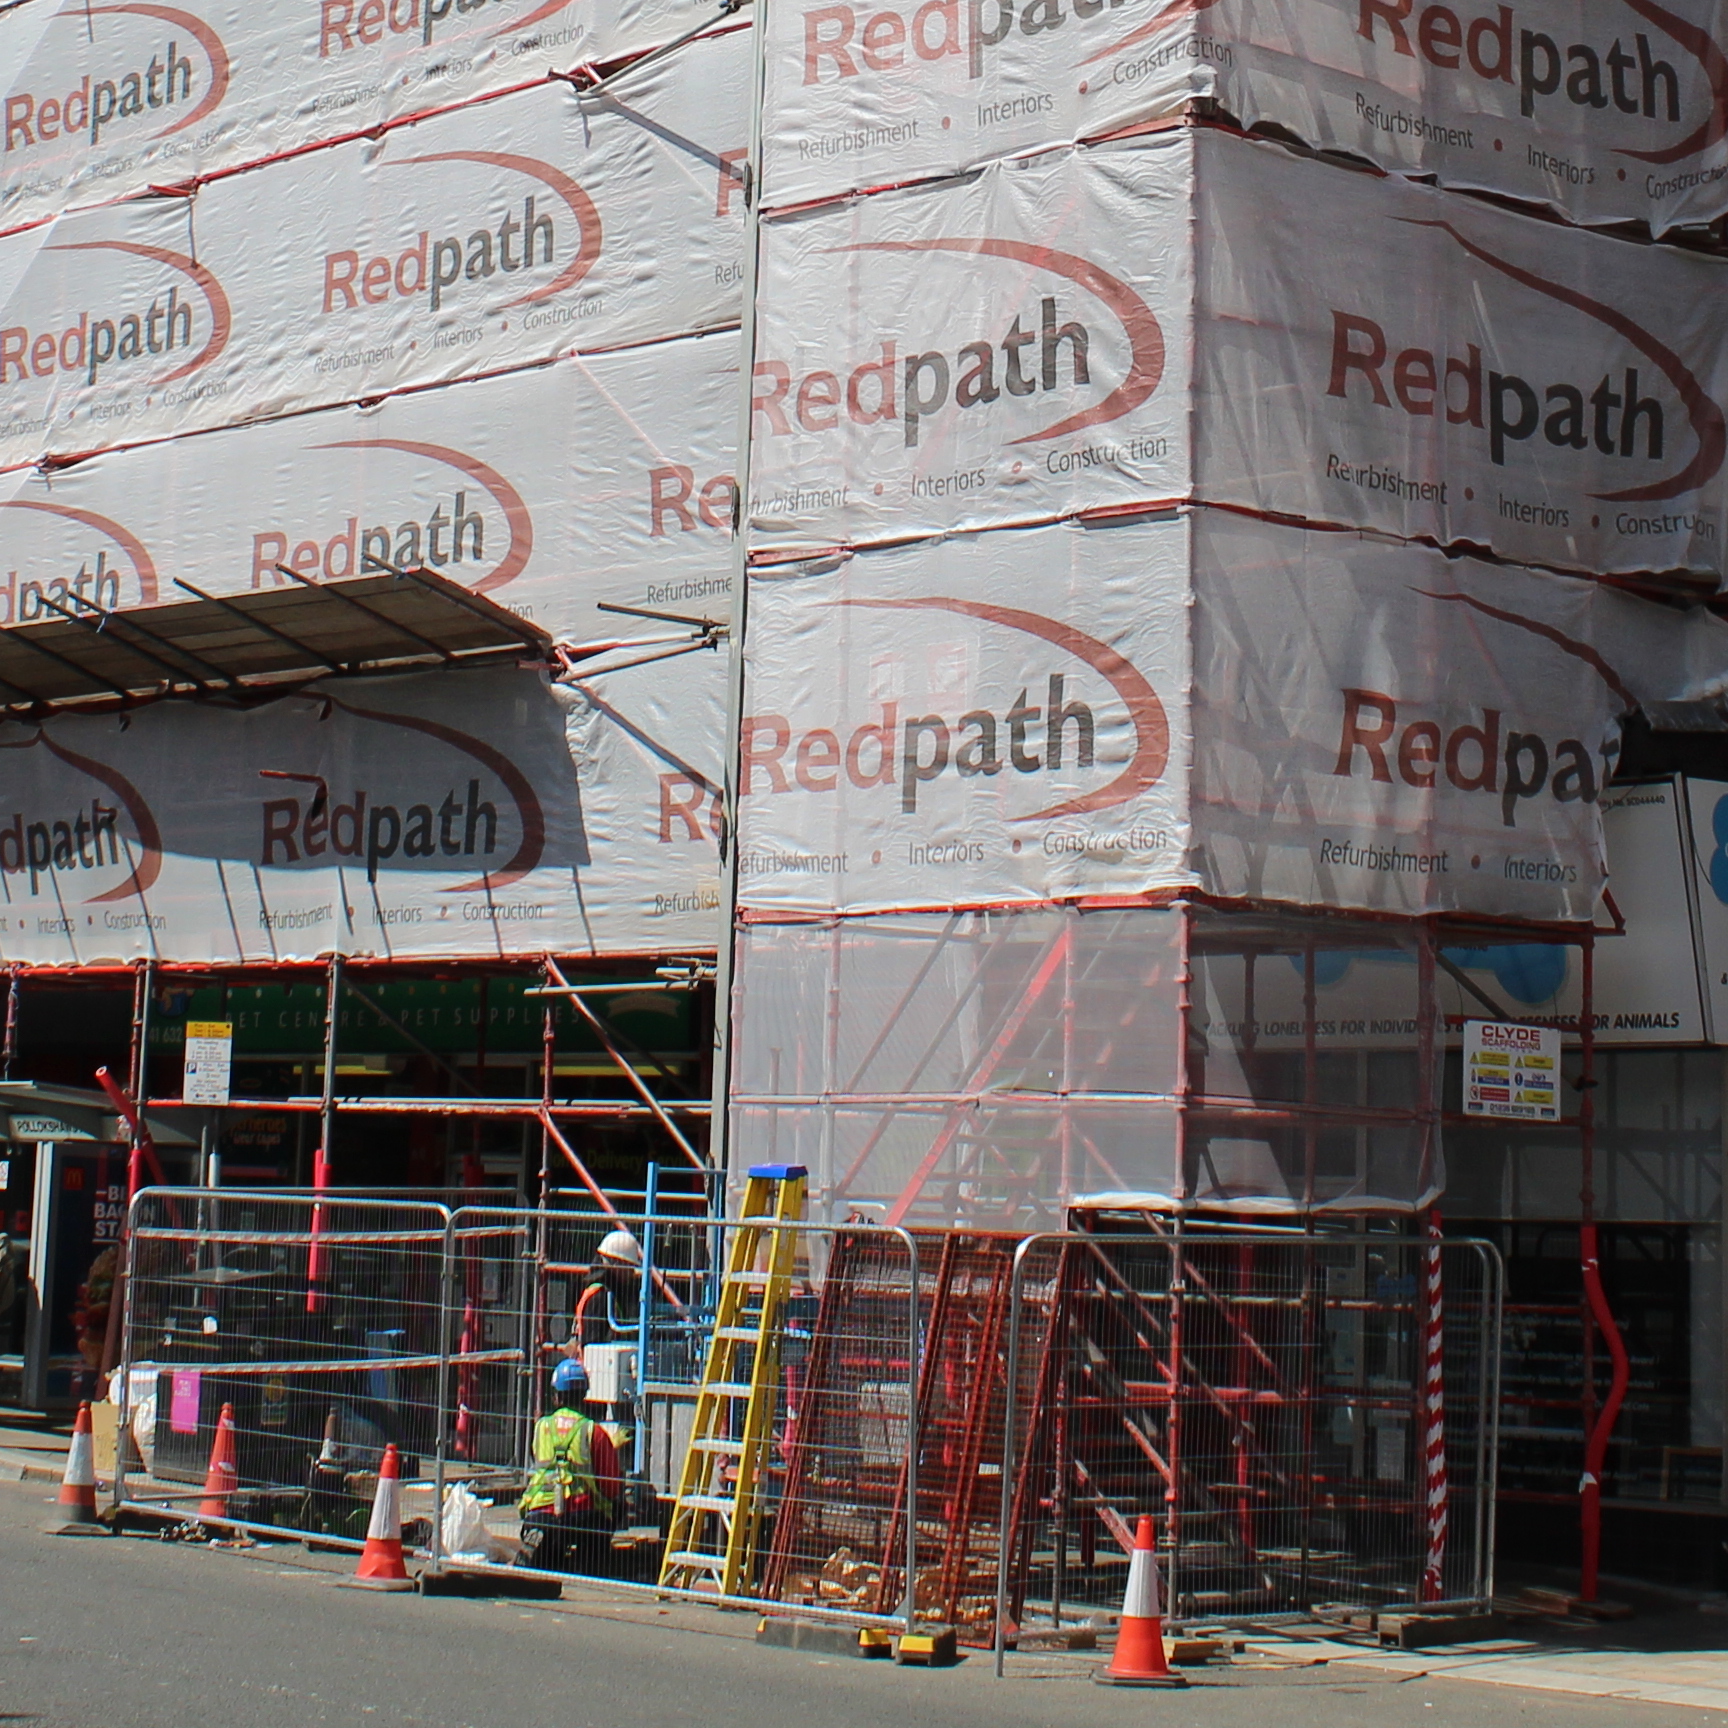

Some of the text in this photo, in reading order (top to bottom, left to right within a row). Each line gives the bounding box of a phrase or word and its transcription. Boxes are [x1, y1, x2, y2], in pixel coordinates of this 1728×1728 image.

[4, 41, 192, 151] Redpath
[798, 92, 1054, 161] Refurbishment Interiors
[322, 196, 554, 313] Redpath
[750, 297, 1090, 447] Redpath
[1326, 309, 1663, 466] Redpath
[911, 467, 985, 499] Interiors
[1498, 493, 1569, 527] Interiors
[741, 674, 1095, 814] Redpath
[261, 780, 497, 882] Redpath
[909, 841, 985, 867] Interiors
[162, 1027, 183, 1043] 632
[279, 1010, 368, 1030] CENRE
[1482, 1025, 1541, 1042] CLYDE
[1614, 1012, 1680, 1030] ANIMALS
[1481, 1037, 1541, 1051] SCAFFOLDING
